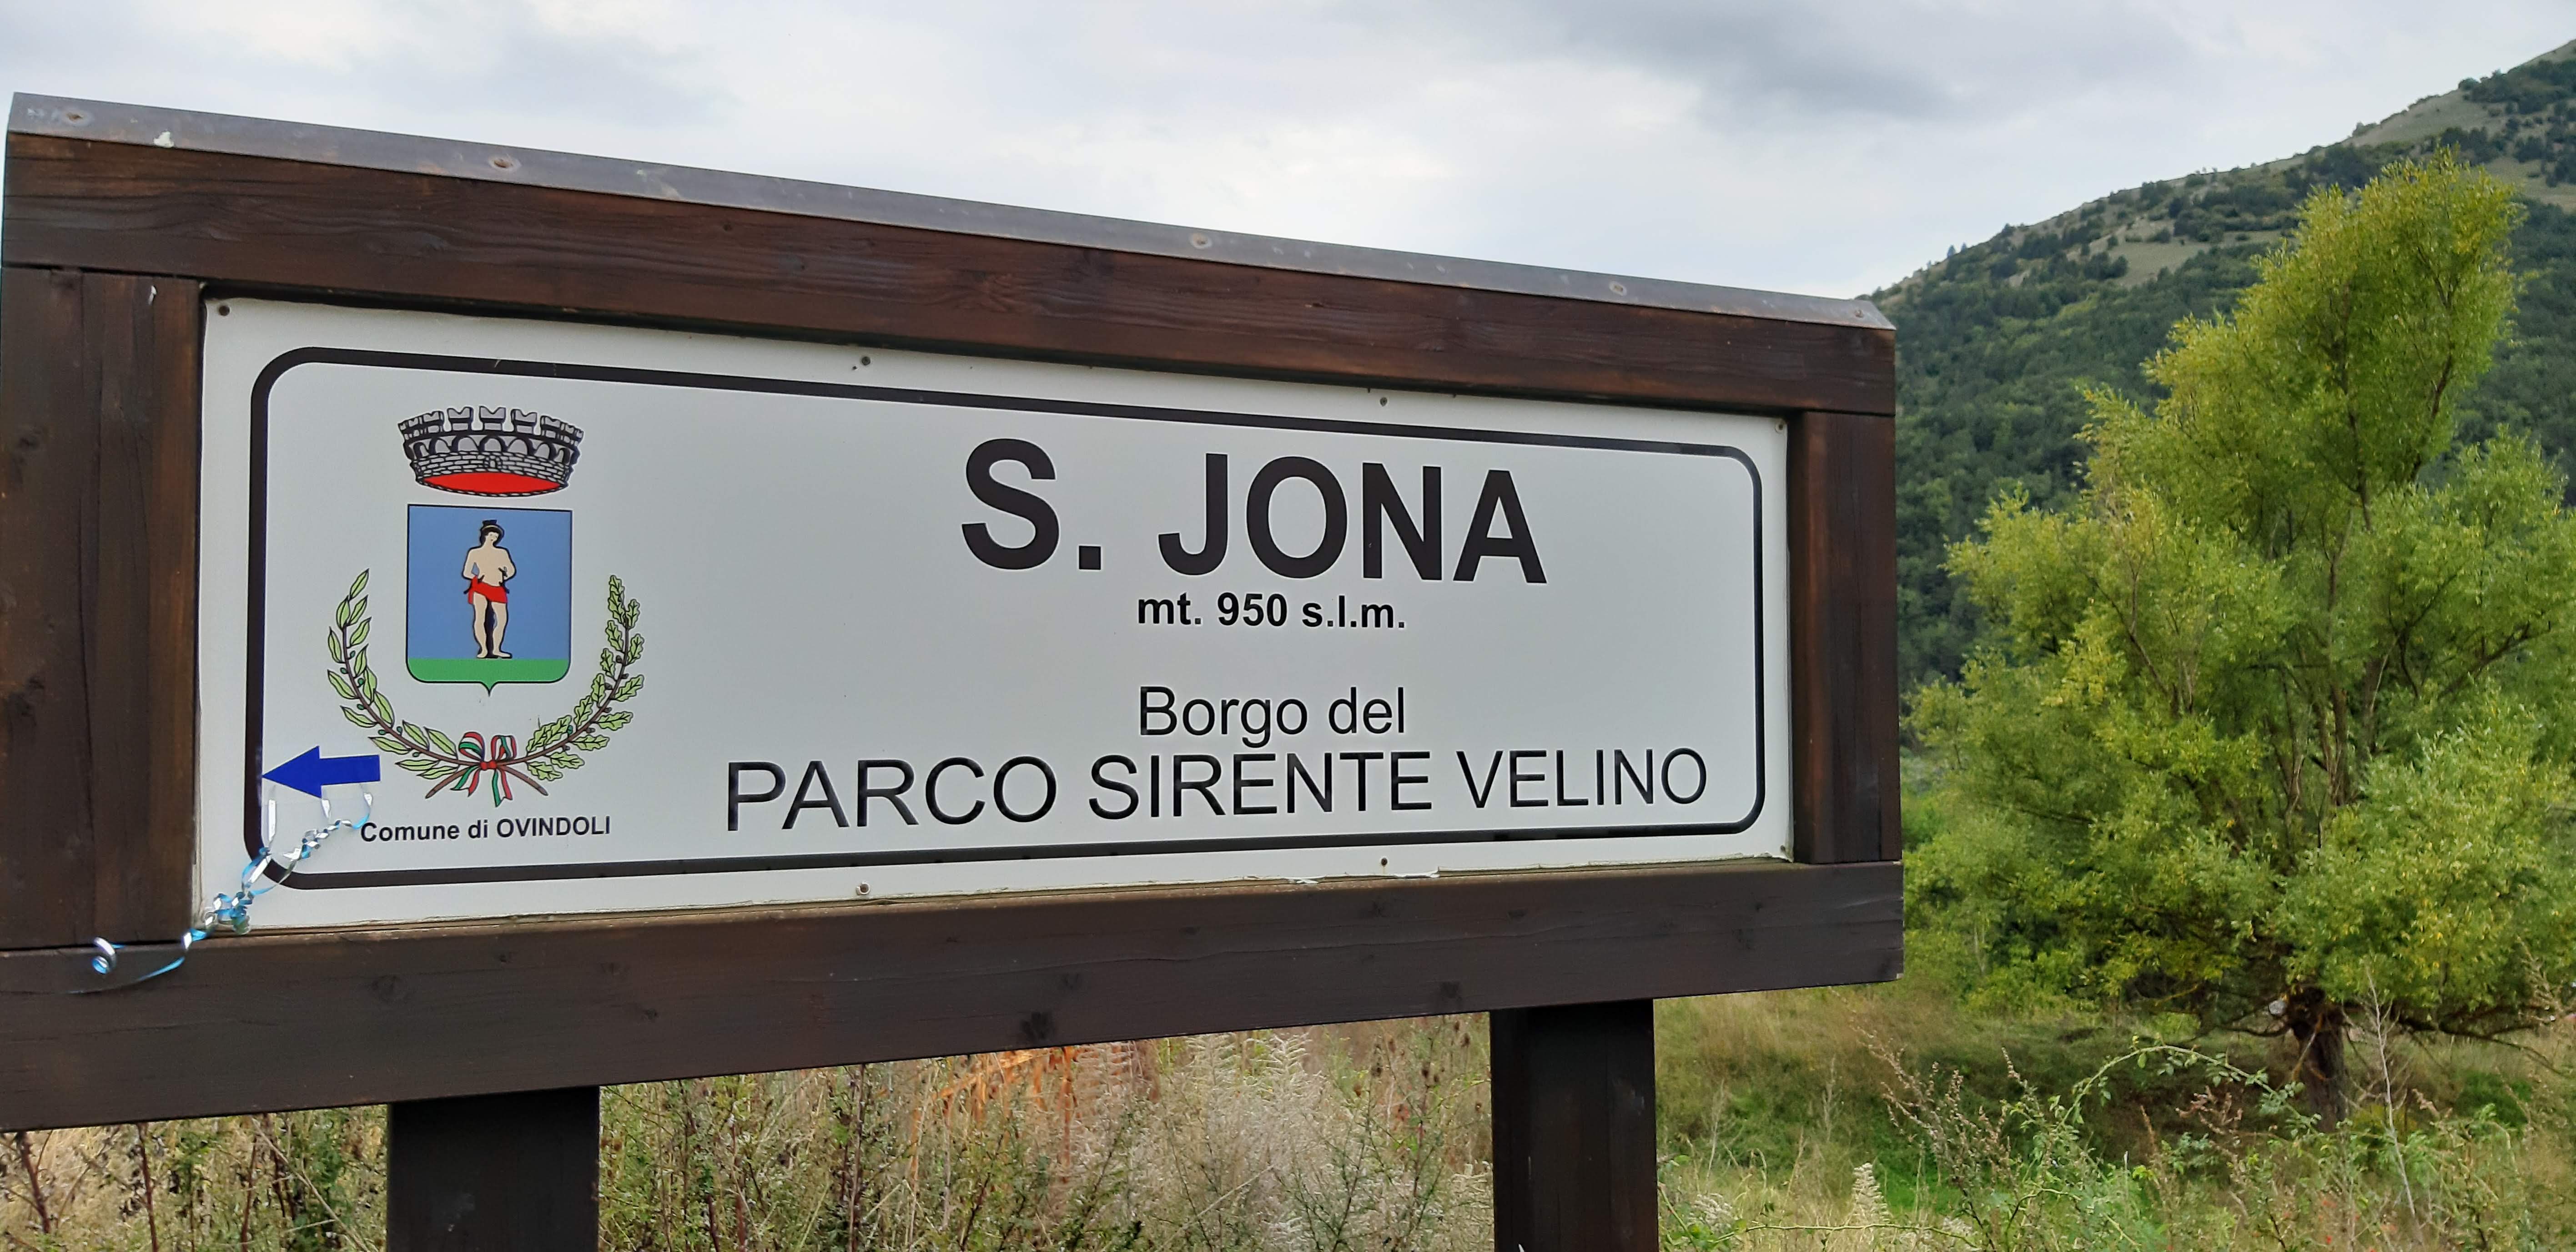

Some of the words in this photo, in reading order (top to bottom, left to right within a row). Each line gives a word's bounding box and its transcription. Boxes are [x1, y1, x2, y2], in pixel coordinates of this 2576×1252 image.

[961, 438, 1102, 571] S.
[1157, 452, 1547, 585] JONA
[1138, 592, 1202, 626] mt.
[1217, 591, 1288, 627] 950
[1302, 595, 1405, 629] s.l.m.
[1140, 686, 1308, 749] Borgo
[1328, 686, 1404, 735] del
[727, 756, 1057, 832] PARCO
[1088, 751, 1432, 820] SIRENTE
[1455, 747, 1707, 809] VELINO
[360, 822, 460, 843] Comune
[468, 819, 488, 839] di
[496, 815, 610, 838] OVINDOLI
